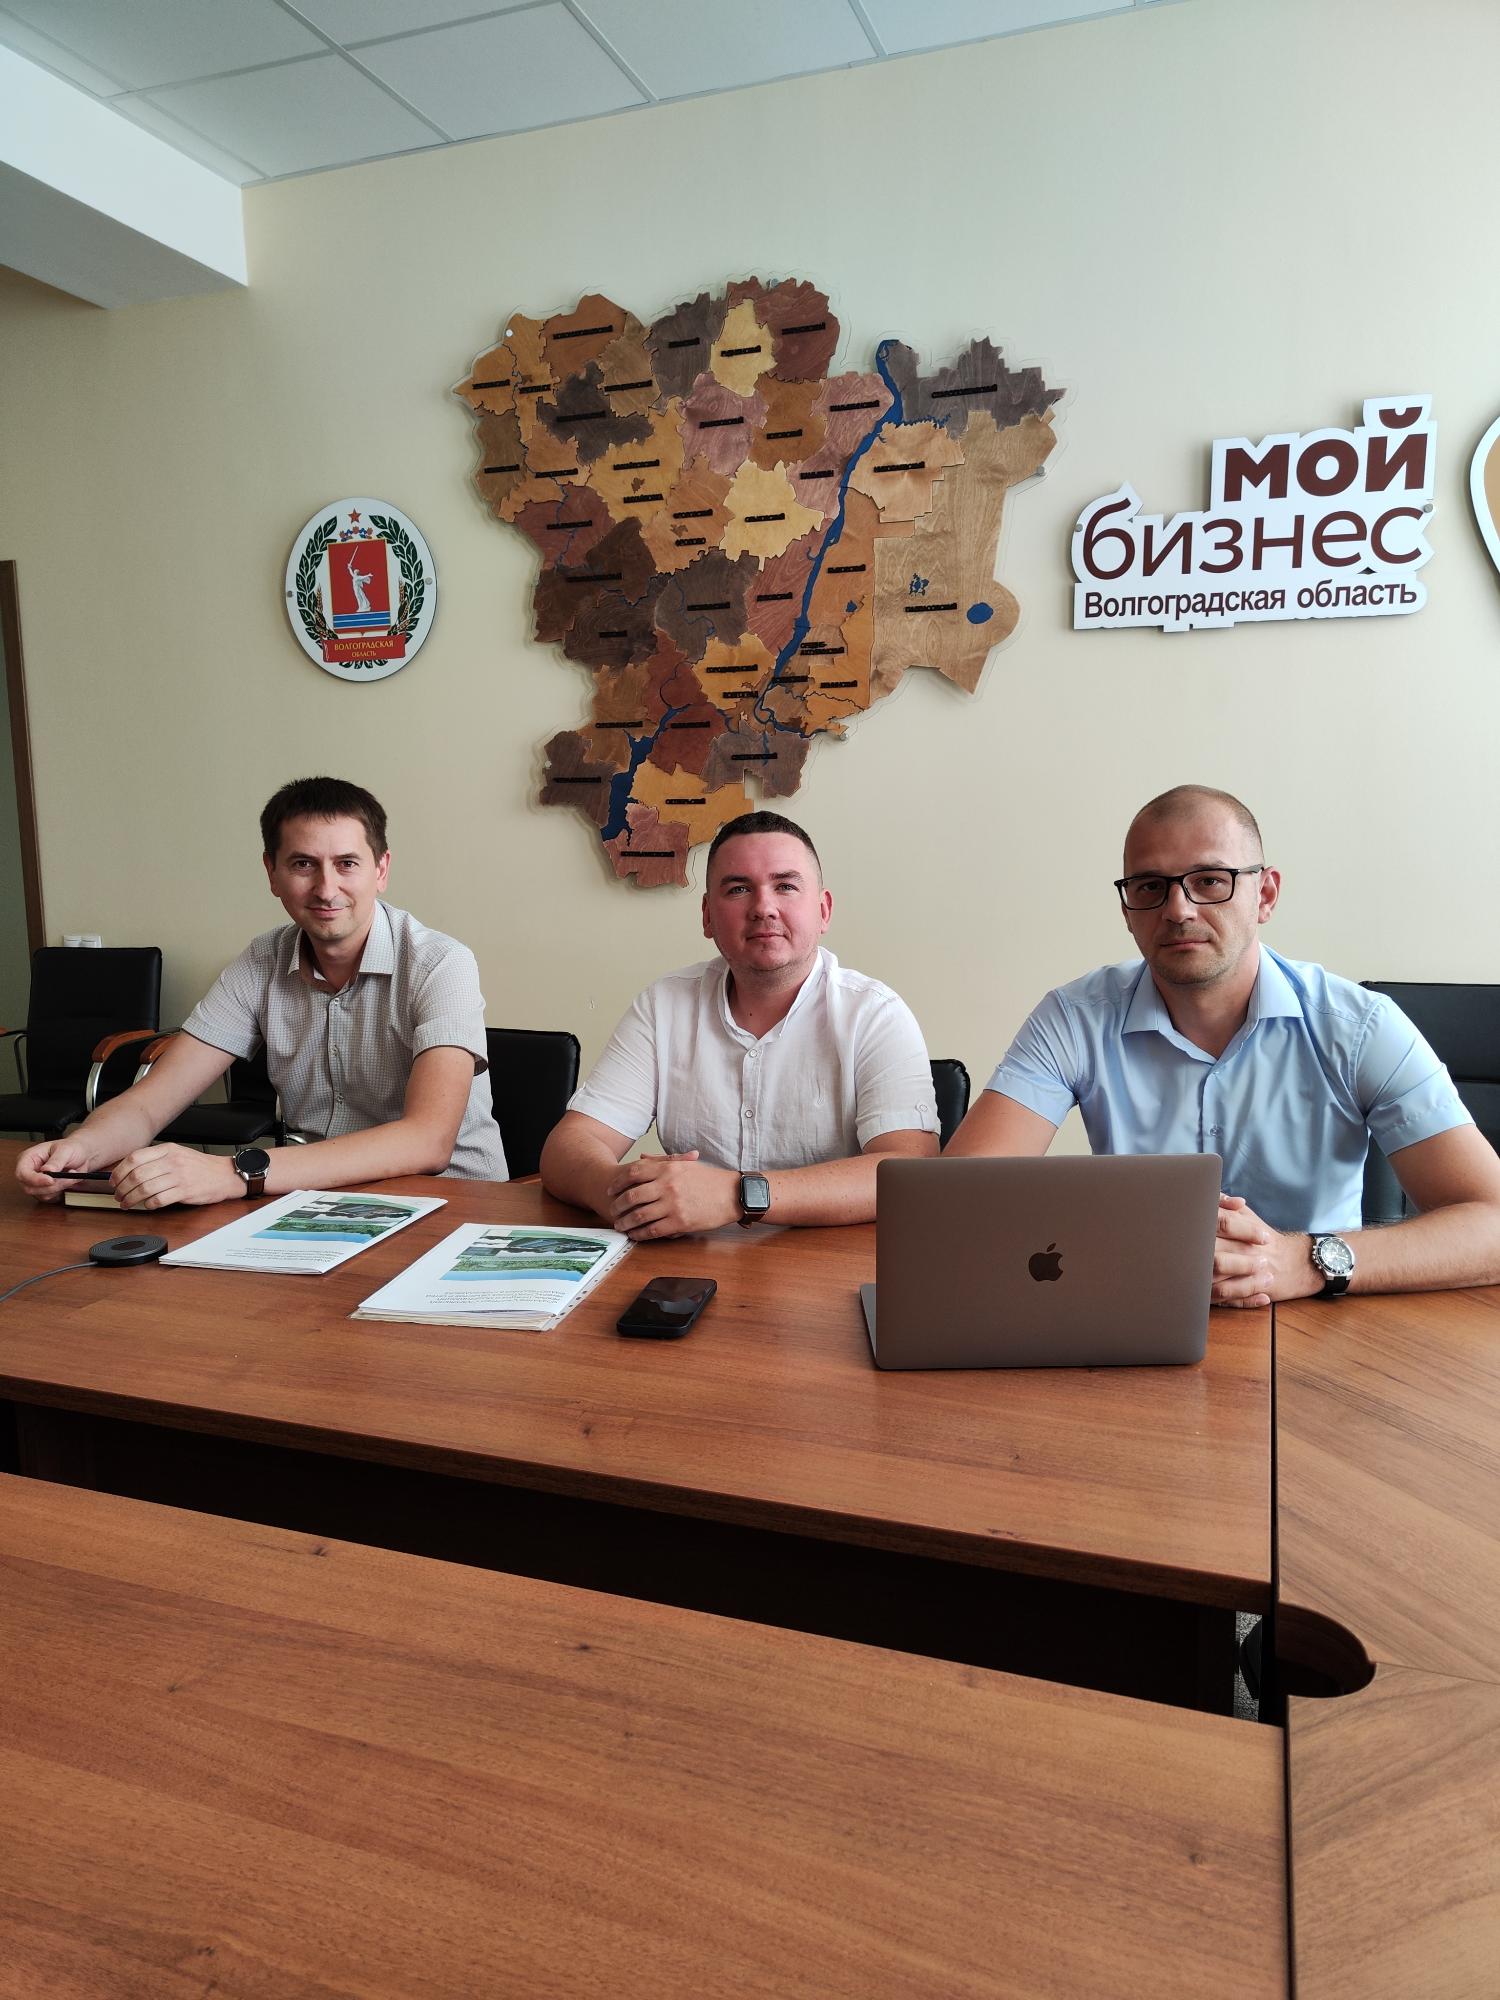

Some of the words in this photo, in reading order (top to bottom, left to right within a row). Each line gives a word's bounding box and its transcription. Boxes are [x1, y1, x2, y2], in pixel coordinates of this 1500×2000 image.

[1223, 406, 1428, 503] мой
[1082, 497, 1424, 581] бизнес
[1084, 589, 1286, 621] Волгоградская
[1297, 578, 1417, 609] область
[334, 640, 394, 651] ВОЛГОГРАДСКАЯ
[351, 650, 377, 658] ОБЛАСТЬ
